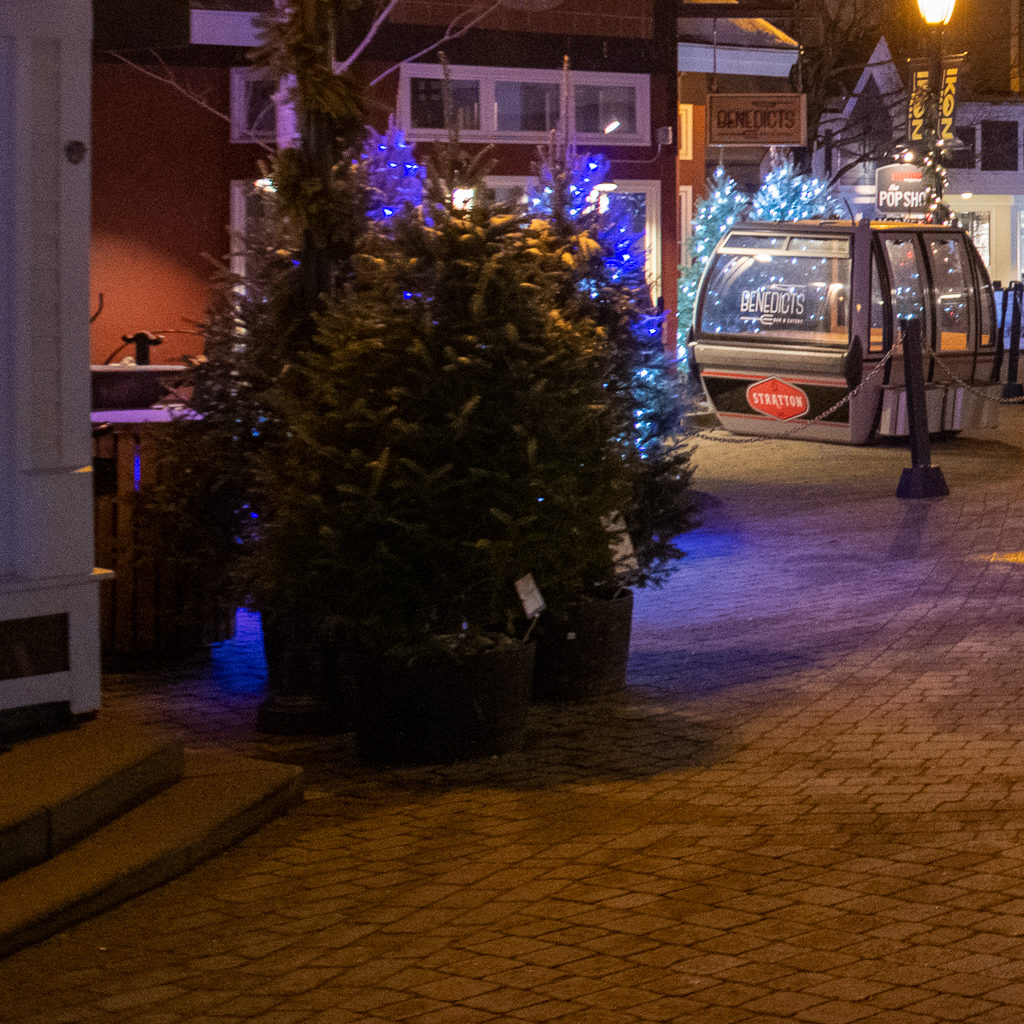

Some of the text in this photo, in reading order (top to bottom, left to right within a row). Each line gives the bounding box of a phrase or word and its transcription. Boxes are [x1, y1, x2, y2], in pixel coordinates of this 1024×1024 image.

[941, 68, 958, 140] IKON
[717, 109, 796, 128] BENEDICTS
[879, 191, 903, 207] POP
[740, 289, 805, 315] BENEDICTS
[752, 392, 803, 409] STRATTON
